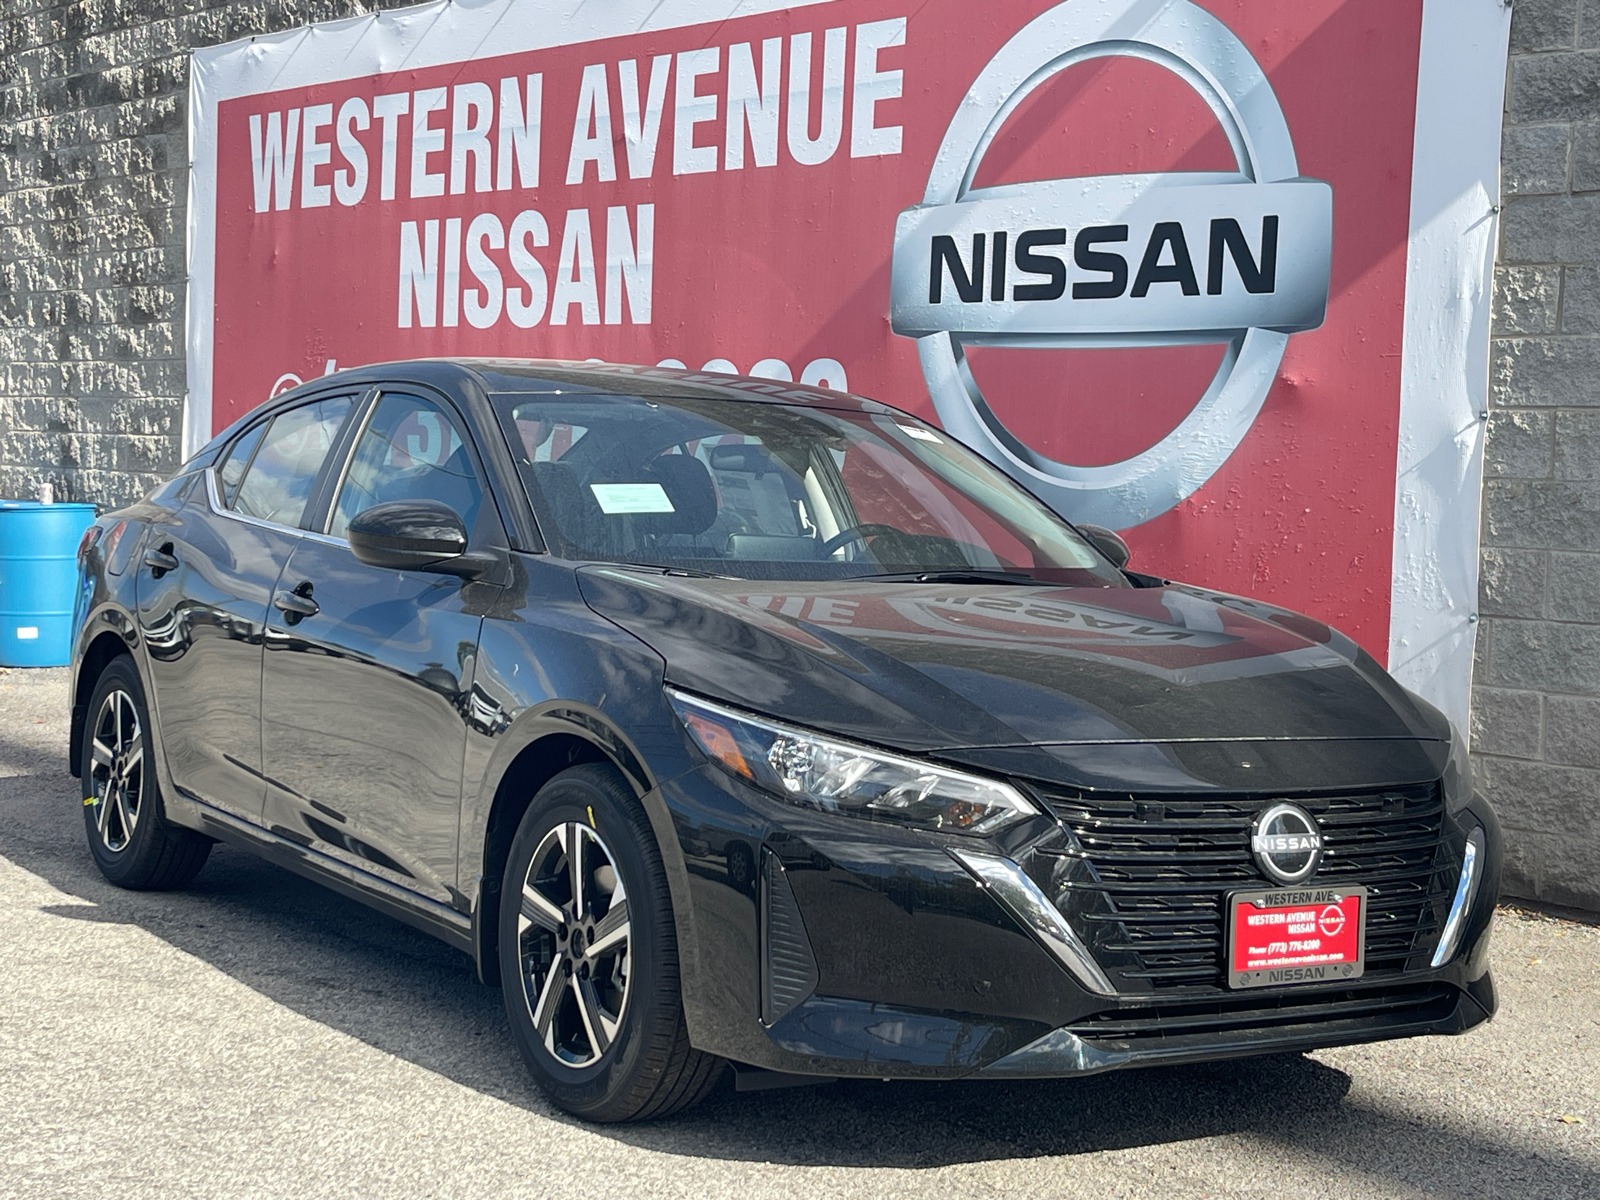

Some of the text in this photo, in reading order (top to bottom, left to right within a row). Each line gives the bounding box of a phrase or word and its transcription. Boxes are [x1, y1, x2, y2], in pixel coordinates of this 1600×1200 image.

[248, 16, 907, 213] WESTERN AVENUE
[398, 203, 655, 329] NISSAN
[929, 215, 1279, 304] NISSAN
[1255, 836, 1320, 851] NISSAN
[1265, 893, 1312, 905] WESTERN
[1248, 911, 1316, 926] WESTERN AVENUE
[1318, 916, 1345, 924] NISSAN
[1288, 923, 1315, 934] NISSAN
[1268, 942, 1287, 955] (773)
[1269, 967, 1325, 982] NISSAN
